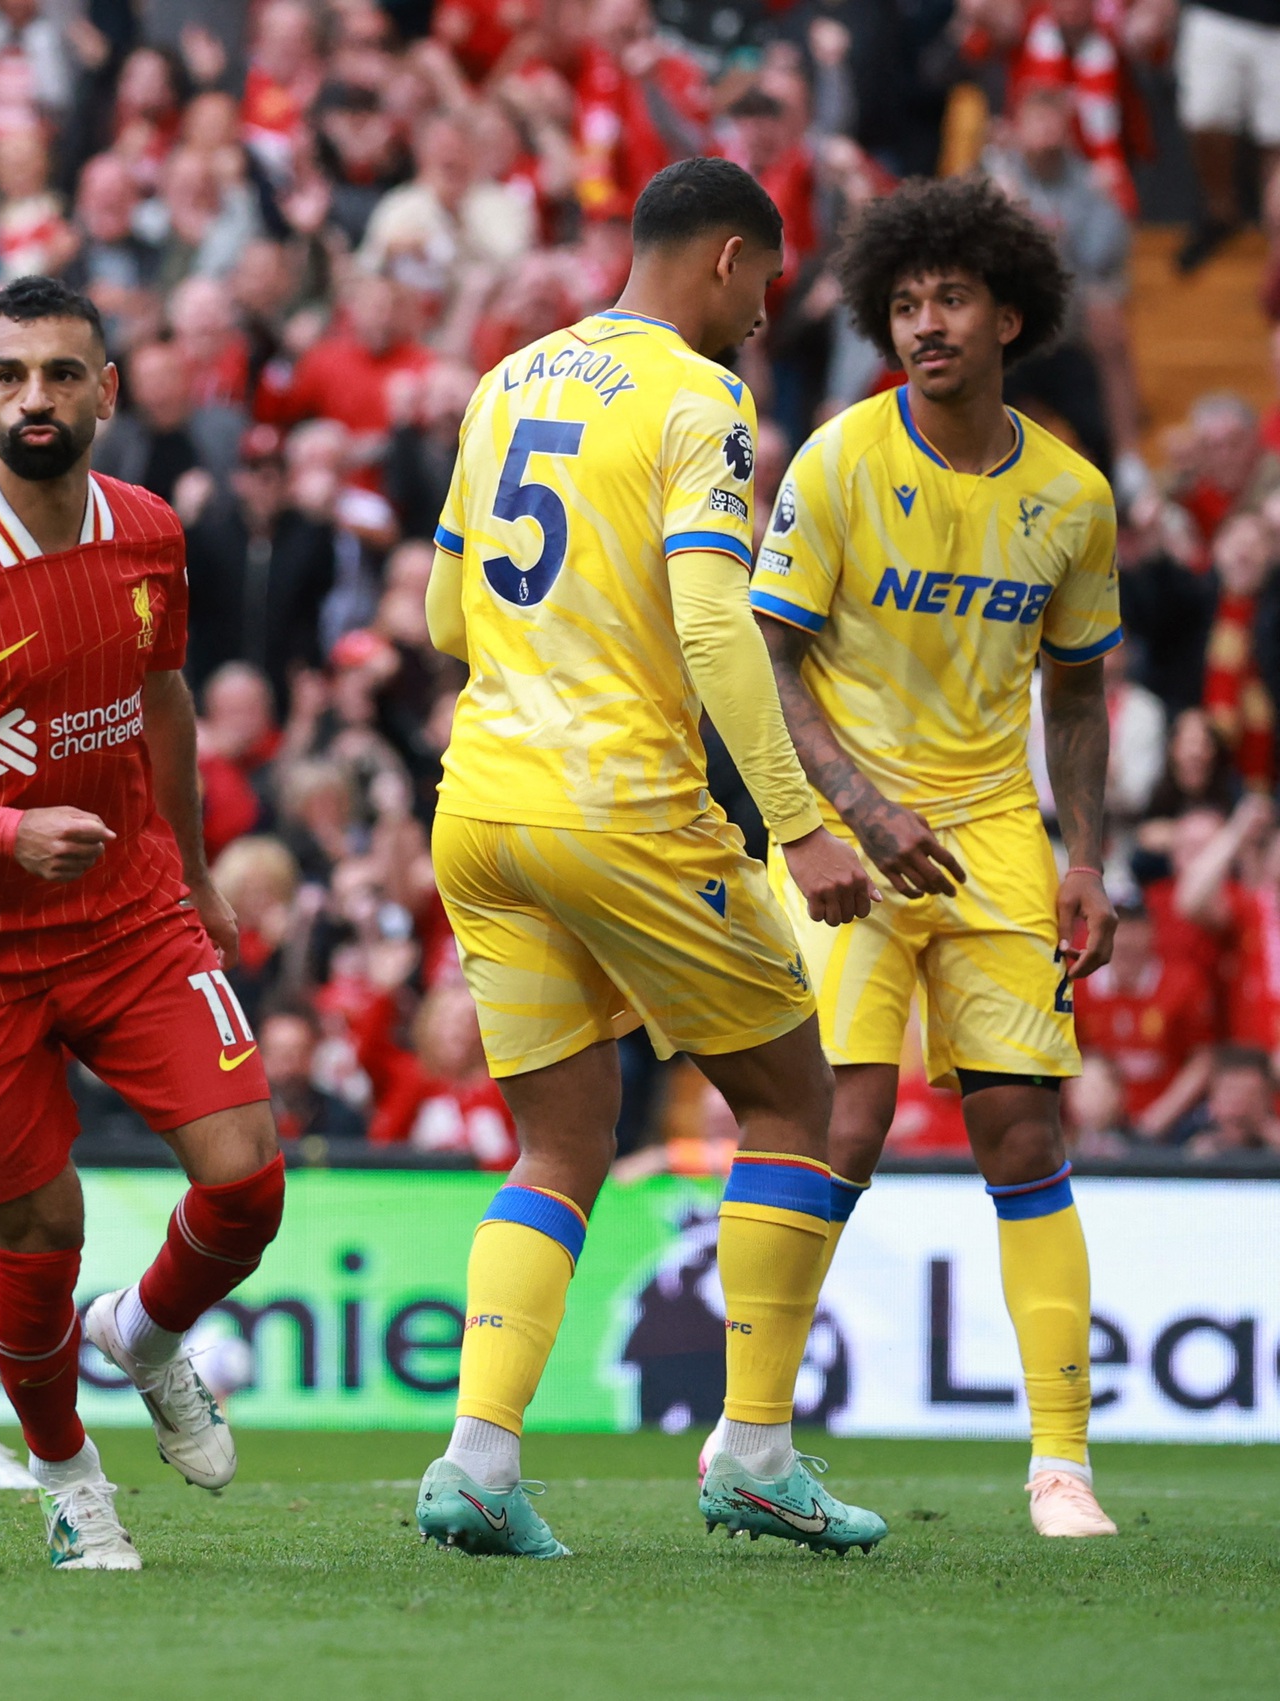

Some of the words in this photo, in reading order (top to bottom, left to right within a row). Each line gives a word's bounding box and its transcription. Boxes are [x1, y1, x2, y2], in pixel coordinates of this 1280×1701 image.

[503, 349, 635, 407] LACROIX
[483, 418, 586, 607] 5
[710, 488, 727, 502] No
[710, 499, 726, 511] for
[871, 567, 1055, 625] NET88
[187, 969, 255, 1047] 11
